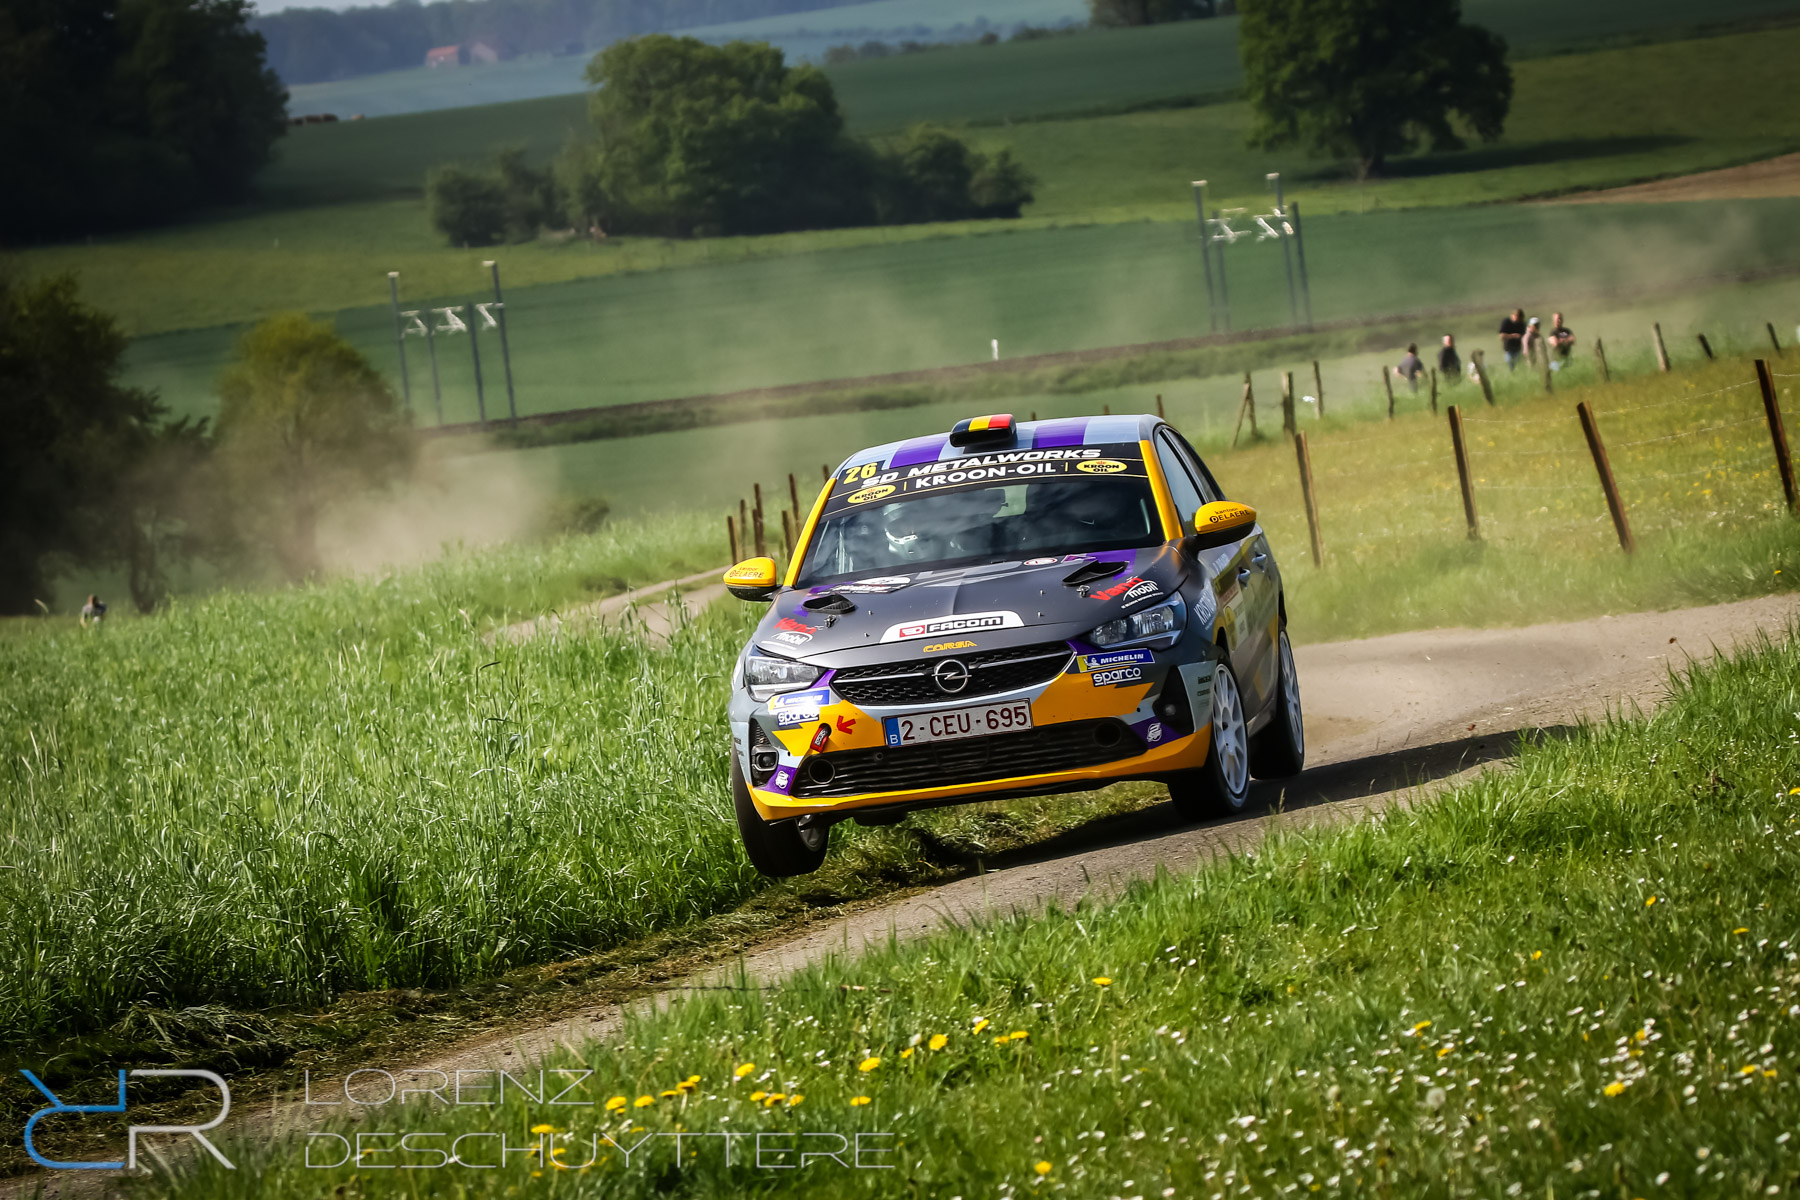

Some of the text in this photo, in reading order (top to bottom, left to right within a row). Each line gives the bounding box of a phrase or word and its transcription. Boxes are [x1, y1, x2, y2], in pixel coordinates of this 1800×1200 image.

[843, 462, 878, 485] 26
[861, 448, 1102, 489] SD METALWORKS
[915, 462, 1056, 489] KROON-OIL
[854, 487, 889, 501] KROON
[1209, 509, 1251, 524] DELAERE
[728, 569, 765, 578] DELAERE
[1128, 582, 1159, 599] mobil
[929, 617, 1001, 632] FACOM
[775, 631, 809, 646] mobil
[922, 640, 978, 653] CORSA
[1100, 653, 1144, 664] MICHELIN
[1093, 667, 1141, 686] sparco
[889, 705, 1028, 745] B 2-CEU-695
